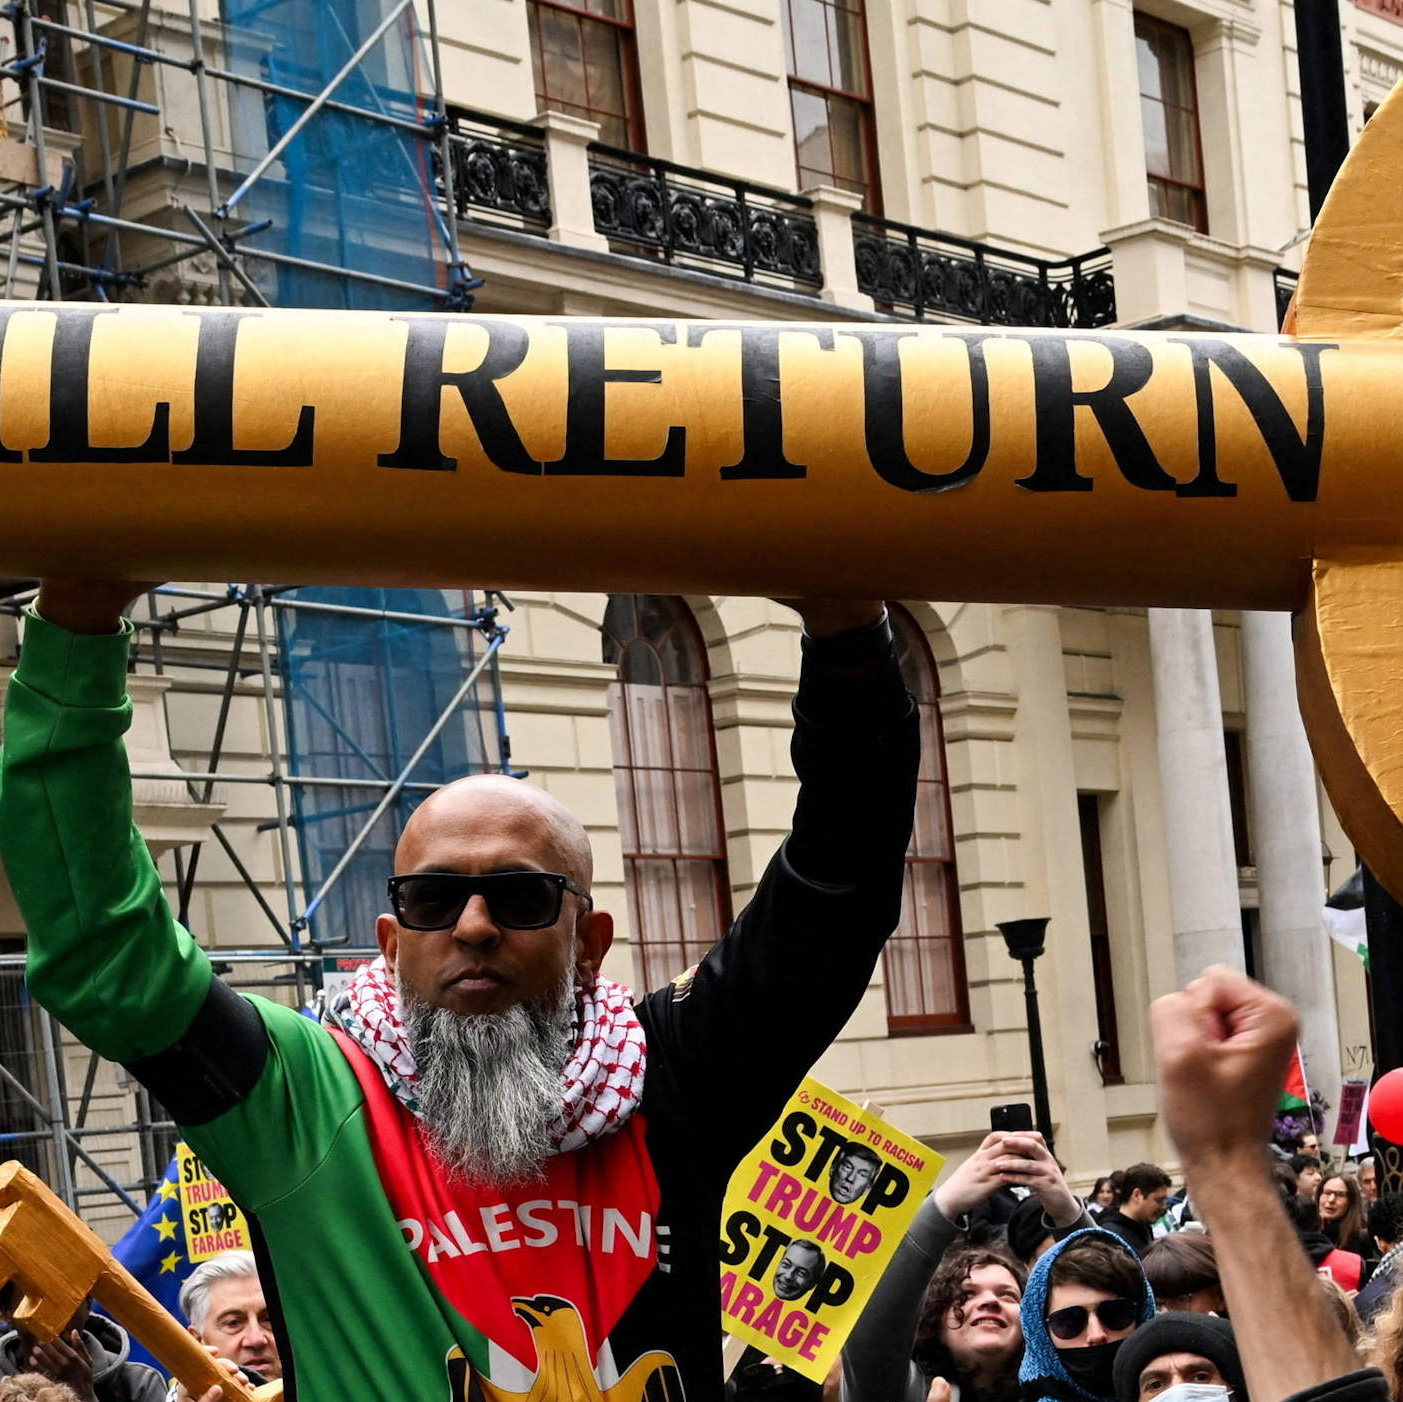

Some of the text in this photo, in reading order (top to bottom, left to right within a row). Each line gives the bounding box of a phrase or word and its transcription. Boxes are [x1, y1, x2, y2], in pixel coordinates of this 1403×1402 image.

[377, 314, 1340, 502] RETURN
[770, 1111, 910, 1216] STOP
[810, 1098, 925, 1172] STAND UP TO RACISM
[186, 1182, 229, 1205] TRUM
[189, 1202, 237, 1236] STOP
[747, 1160, 882, 1260] TRUMP
[191, 1229, 245, 1256] FARAGE
[398, 1199, 672, 1275] PALESTINE
[719, 1210, 855, 1315] STOP
[720, 1271, 830, 1362] ARAGE
